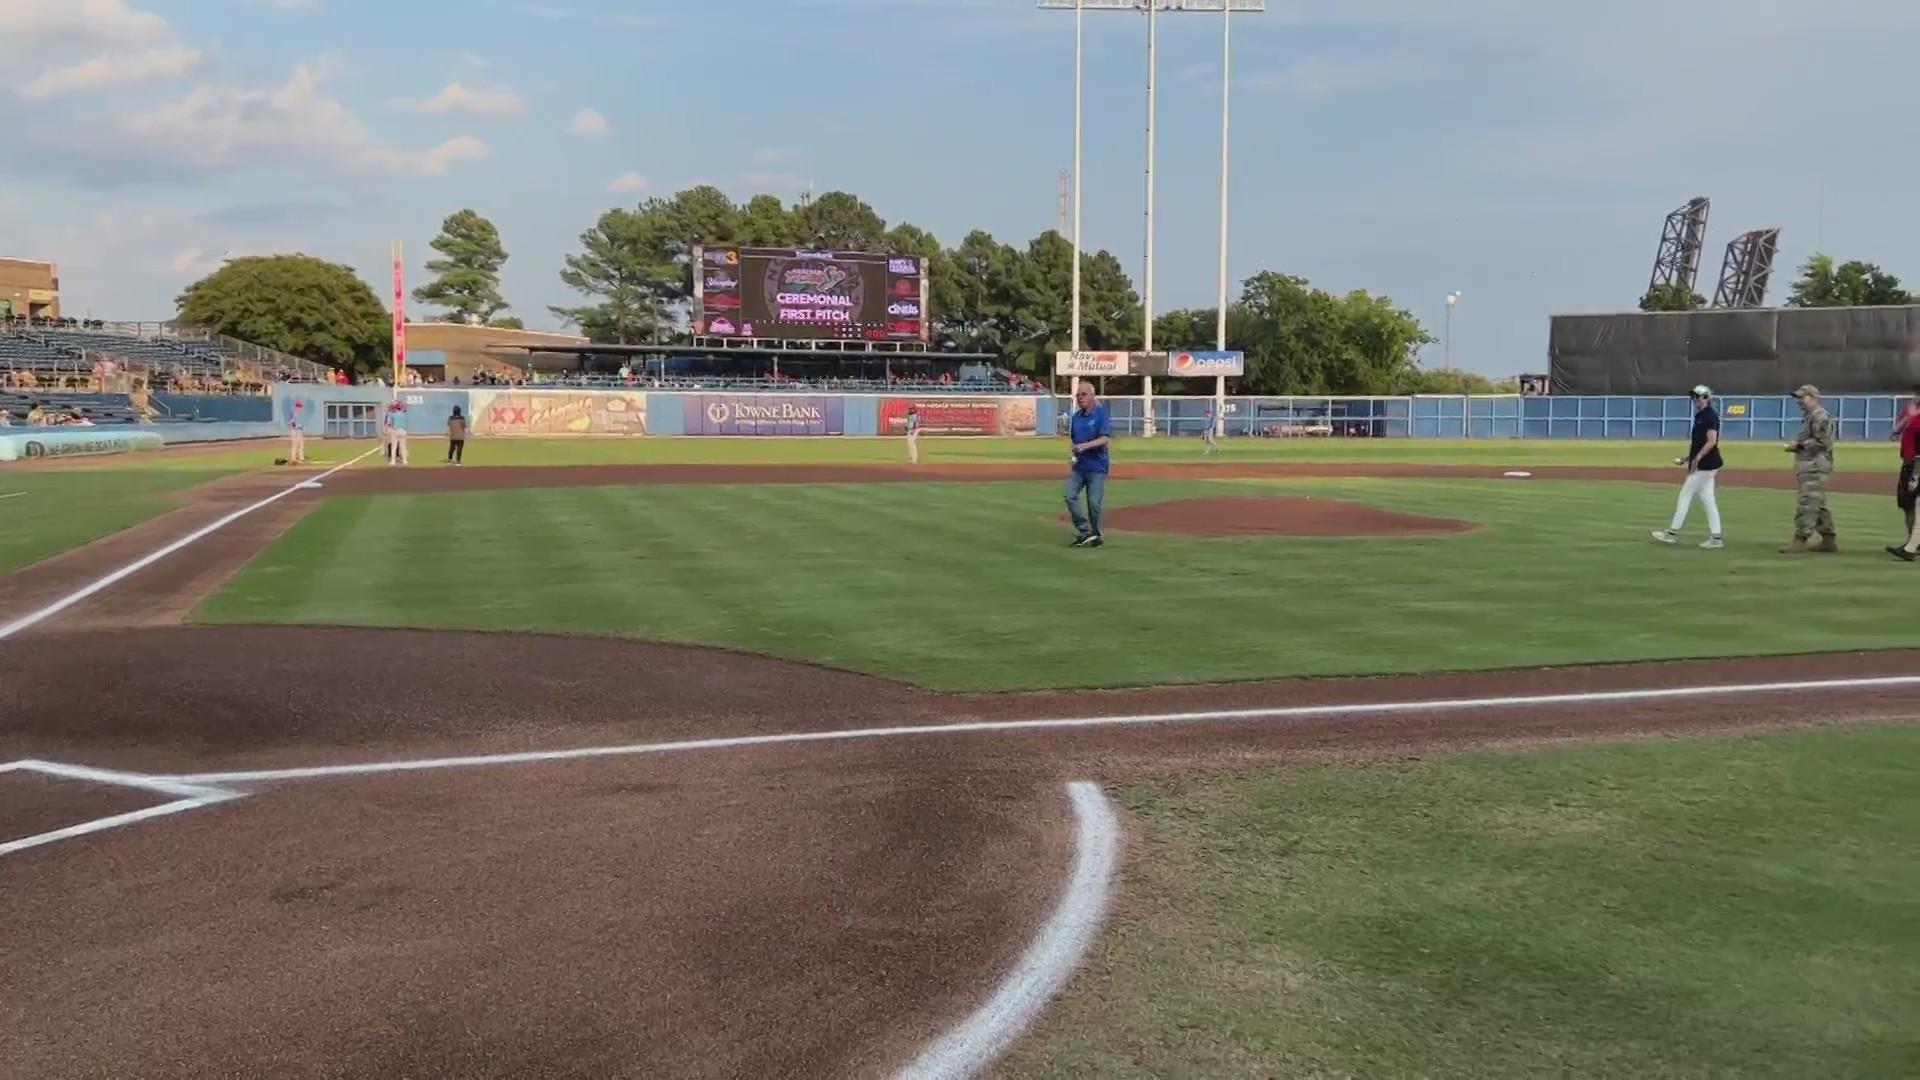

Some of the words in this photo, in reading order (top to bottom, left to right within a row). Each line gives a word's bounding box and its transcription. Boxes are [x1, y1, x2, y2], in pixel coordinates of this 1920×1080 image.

[776, 292, 852, 306] CEREMONIAL
[780, 308, 813, 320] FIRST
[816, 309, 850, 321] PITCH
[1078, 360, 1117, 372] Mutual
